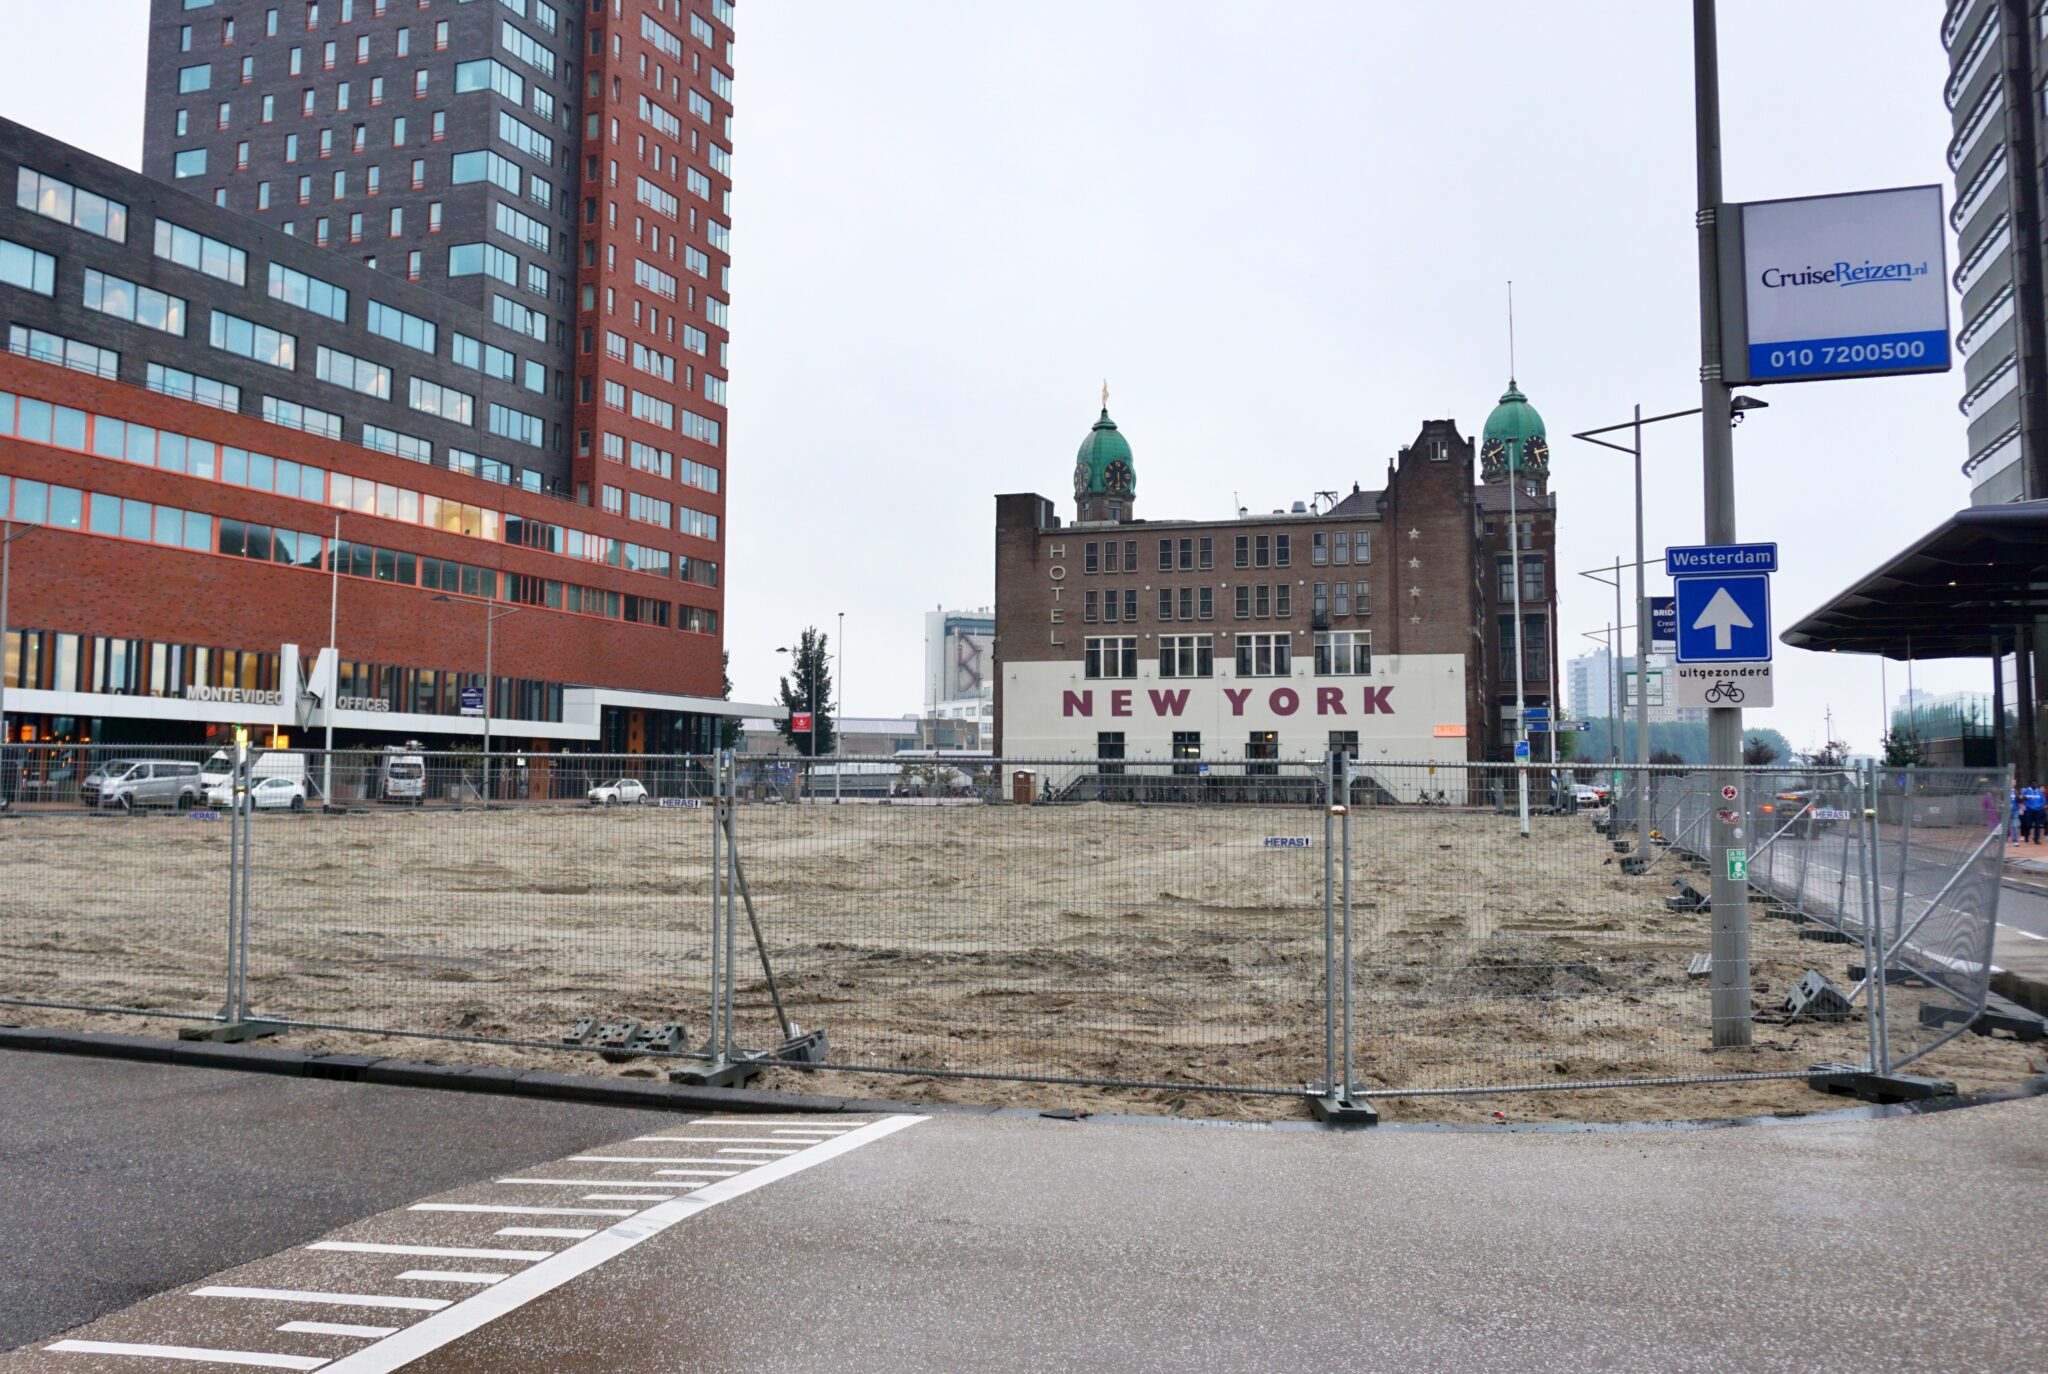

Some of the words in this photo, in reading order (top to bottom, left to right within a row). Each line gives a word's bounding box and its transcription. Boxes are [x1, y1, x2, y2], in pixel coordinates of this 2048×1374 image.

[1761, 261, 1928, 288] CruiseReizen.nl
[1770, 349, 1814, 368] 010
[1821, 340, 1926, 364] 7200500
[1672, 550, 1771, 566] Westerdam
[1049, 543, 1067, 645] HOTEL
[1653, 609, 1675, 617] BRID
[1679, 667, 1770, 680] uitgezonderd
[337, 695, 390, 712] OFFICES
[1062, 689, 1191, 717] NEW
[1223, 686, 1396, 716] YORK
